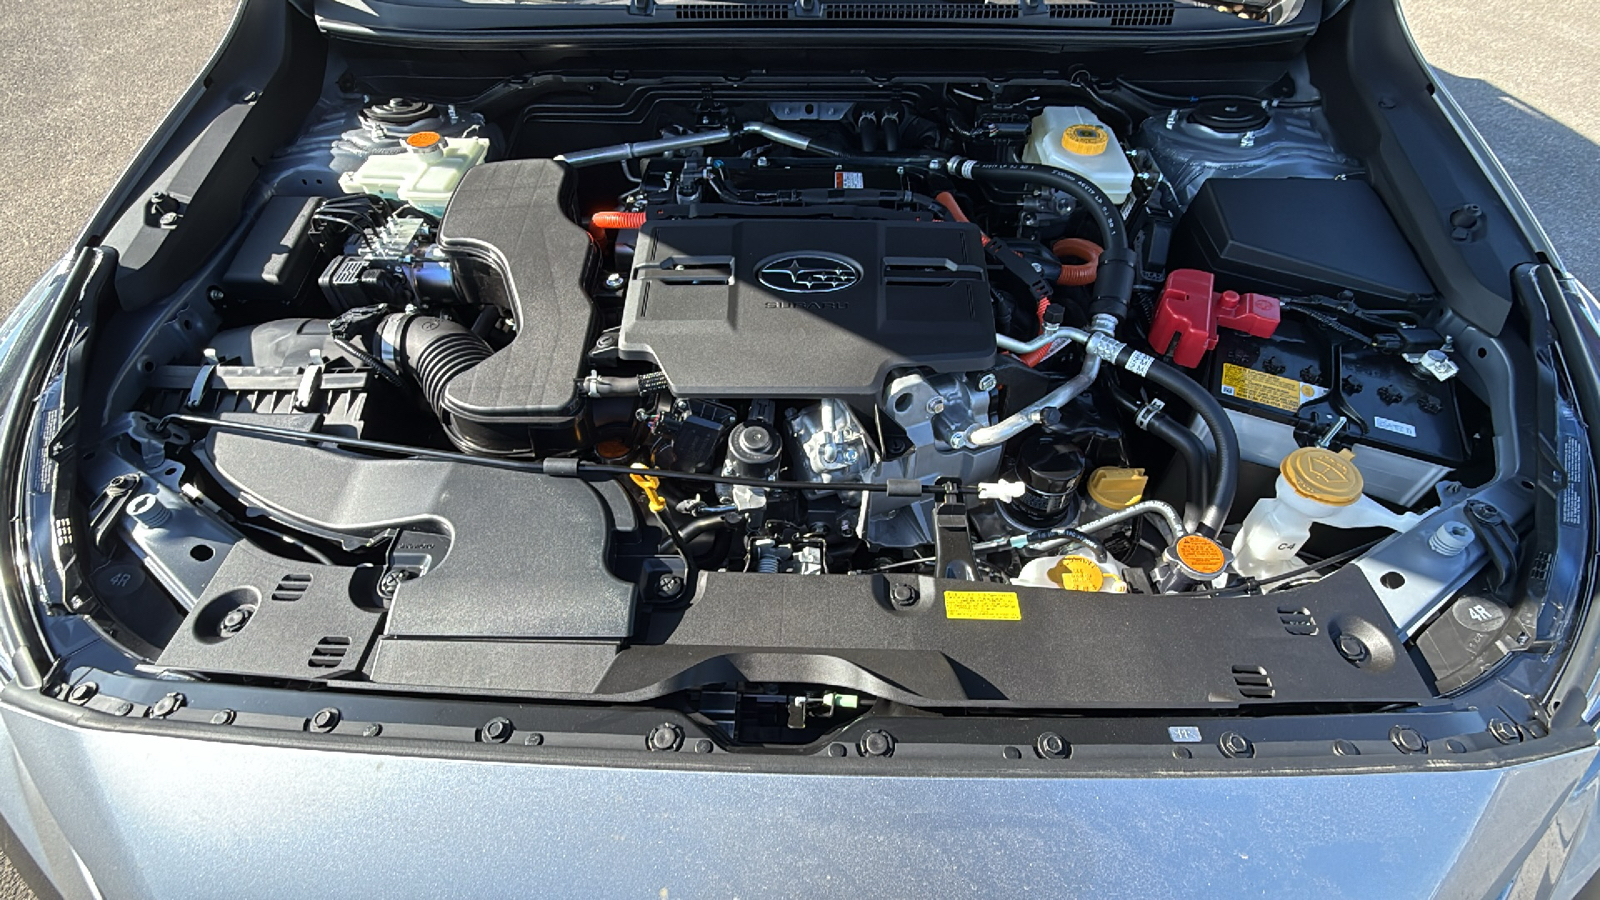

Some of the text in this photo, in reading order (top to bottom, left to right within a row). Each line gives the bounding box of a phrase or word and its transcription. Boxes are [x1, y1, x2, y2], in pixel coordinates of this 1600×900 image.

[764, 301, 850, 309] SUBARU
[1277, 542, 1296, 551] C4
[110, 572, 131, 587] 4R
[1468, 604, 1493, 621] 4R
